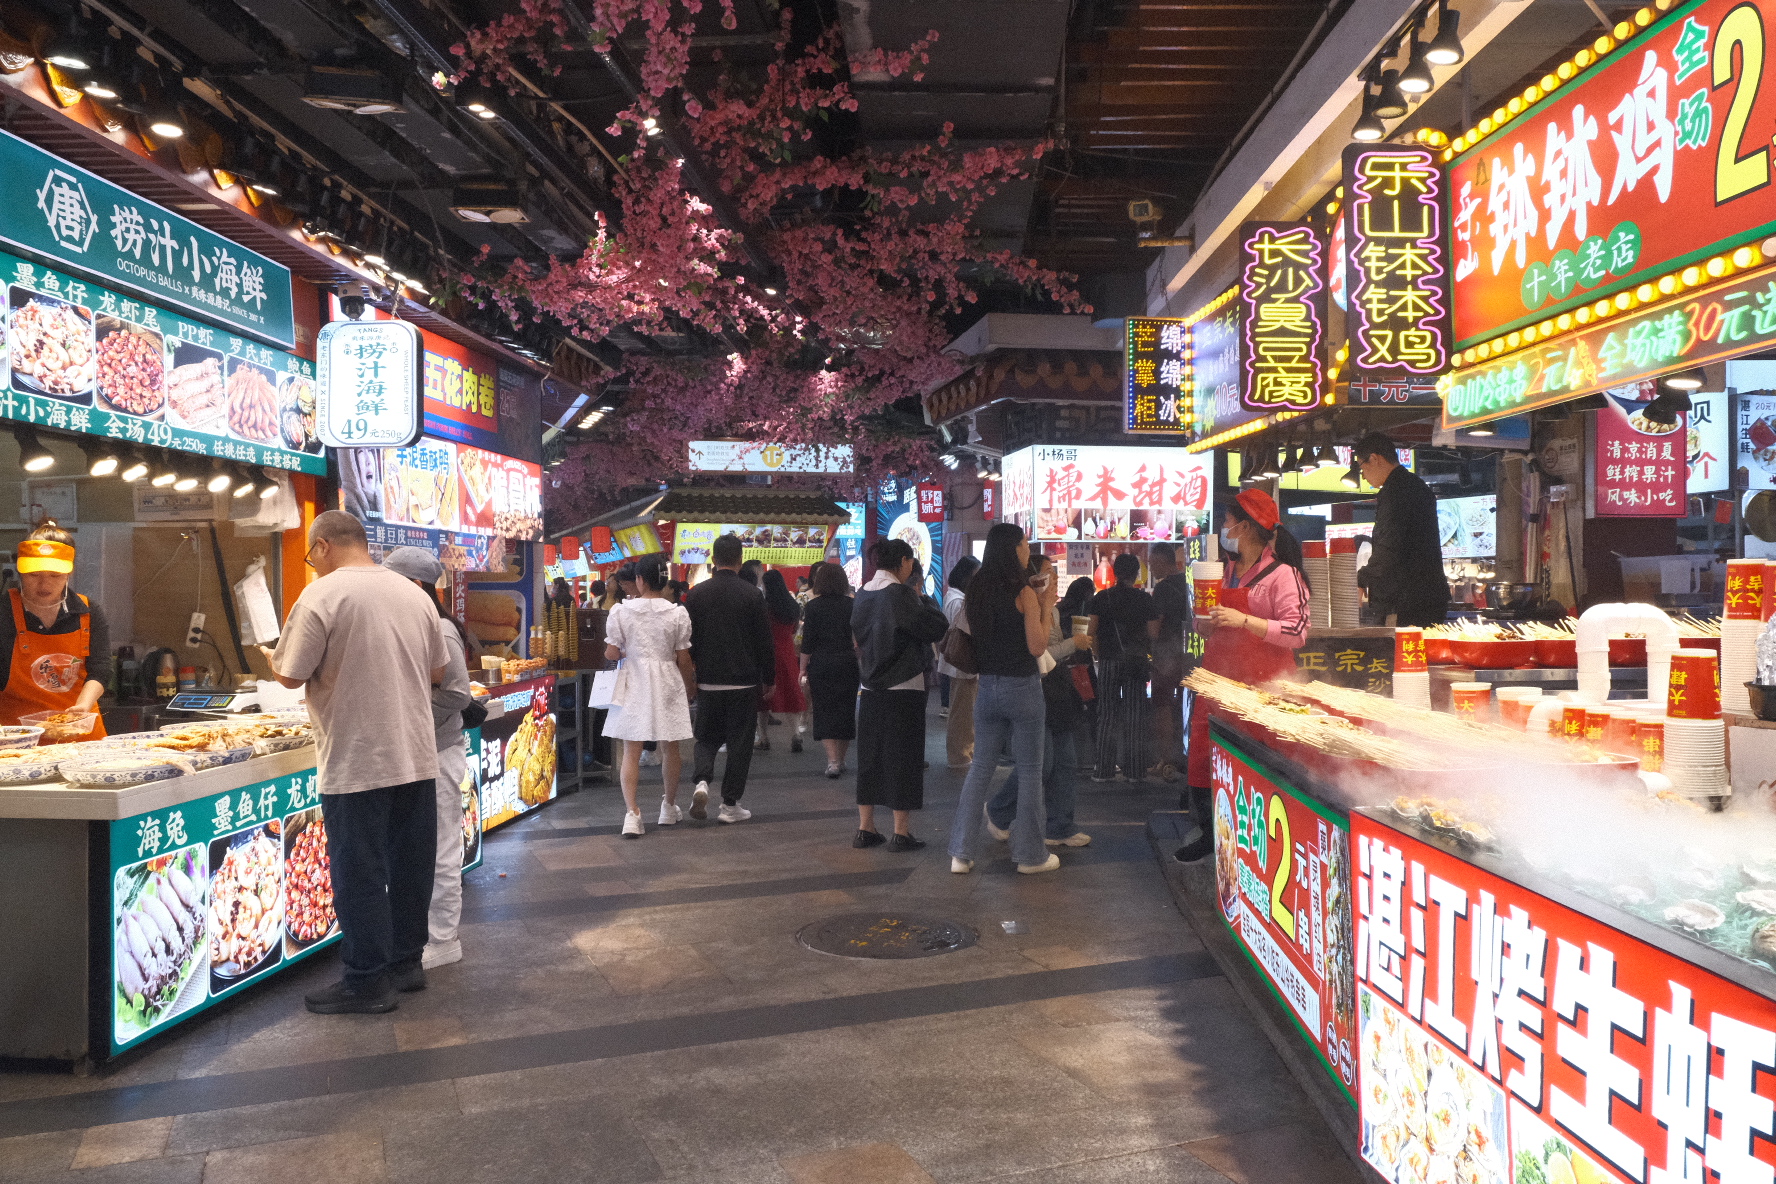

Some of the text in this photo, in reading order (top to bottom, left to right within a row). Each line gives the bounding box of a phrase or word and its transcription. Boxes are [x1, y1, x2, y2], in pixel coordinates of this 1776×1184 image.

[1673, 16, 1713, 151] 全场
[1712, 1, 1771, 207] 2
[1487, 50, 1675, 276] 钵钵鸡
[51, 182, 87, 241] 唐
[1454, 181, 1482, 282] 乐山
[109, 204, 267, 310] 捞汁小海鲜
[116, 257, 157, 282] OCTOPUS
[158, 273, 183, 293] BALLS
[1360, 156, 1436, 368] 乐山钵钵鸡
[1525, 231, 1636, 302] 十年老店
[12, 262, 314, 380] 墨鱼仔 龙虾尾 PP虾 罗氏虾 鲍鱼
[1252, 232, 1314, 404] 长沙臭豆腐
[353, 342, 388, 416] 捞汁海鲜
[424, 350, 495, 418] 五花肉卷
[1133, 324, 1156, 423] 芒掌柜
[1159, 324, 1182, 421] 绵绵冰
[262, 450, 302, 471] 任意搭配
[1037, 448, 1078, 462] 小杨哥
[1606, 440, 1676, 461] 清凉消夏
[1741, 399, 1751, 454] 湛江生蚝
[1041, 462, 1209, 510] 糯米甜酒
[1605, 464, 1676, 483] 鲜榨果汁
[1606, 488, 1677, 507] 风味小吃
[365, 525, 406, 545] 三鲜豆皮
[1298, 649, 1366, 673] 正宗
[1367, 657, 1391, 693] 长沙
[137, 810, 188, 857] 海兔
[211, 784, 278, 835] 墨鱼仔
[1235, 775, 1267, 874] 全场
[1269, 791, 1295, 943] 2
[1357, 834, 1776, 1184] 湛江烤生蚝
